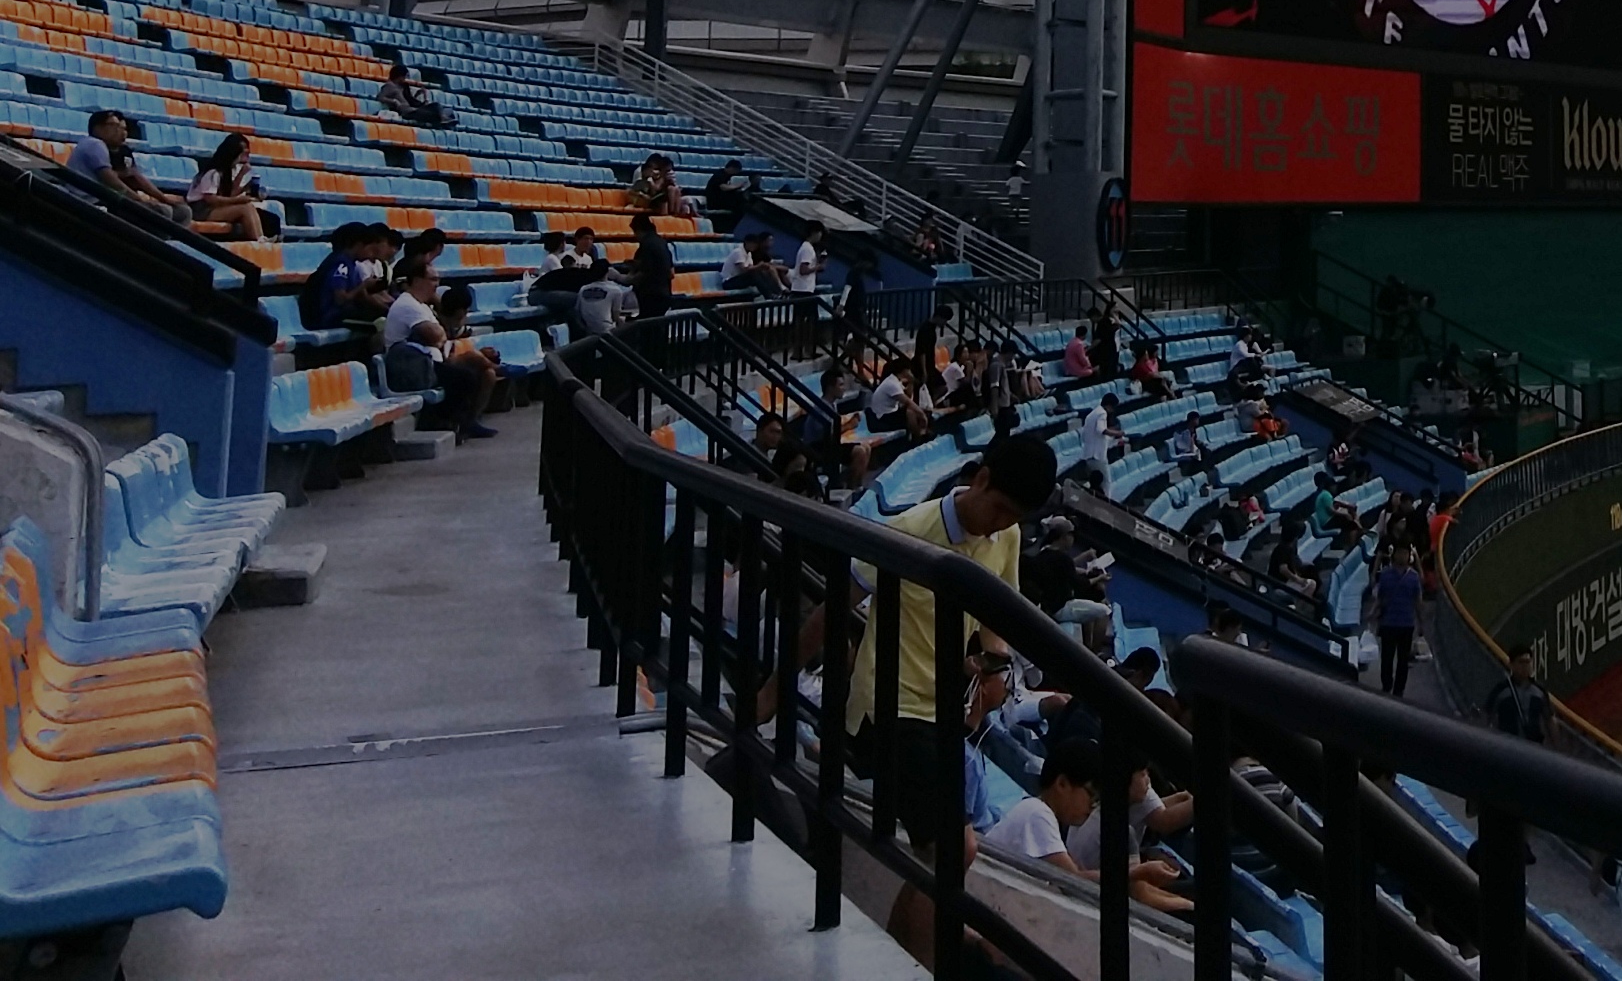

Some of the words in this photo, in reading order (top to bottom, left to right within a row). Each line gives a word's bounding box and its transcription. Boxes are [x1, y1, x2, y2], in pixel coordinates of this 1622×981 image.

[1166, 80, 1381, 177] 롯데홈쇼핑
[1502, 106, 1535, 147] 않는
[1452, 152, 1499, 189] REAL
[1500, 153, 1531, 193] 맥주
